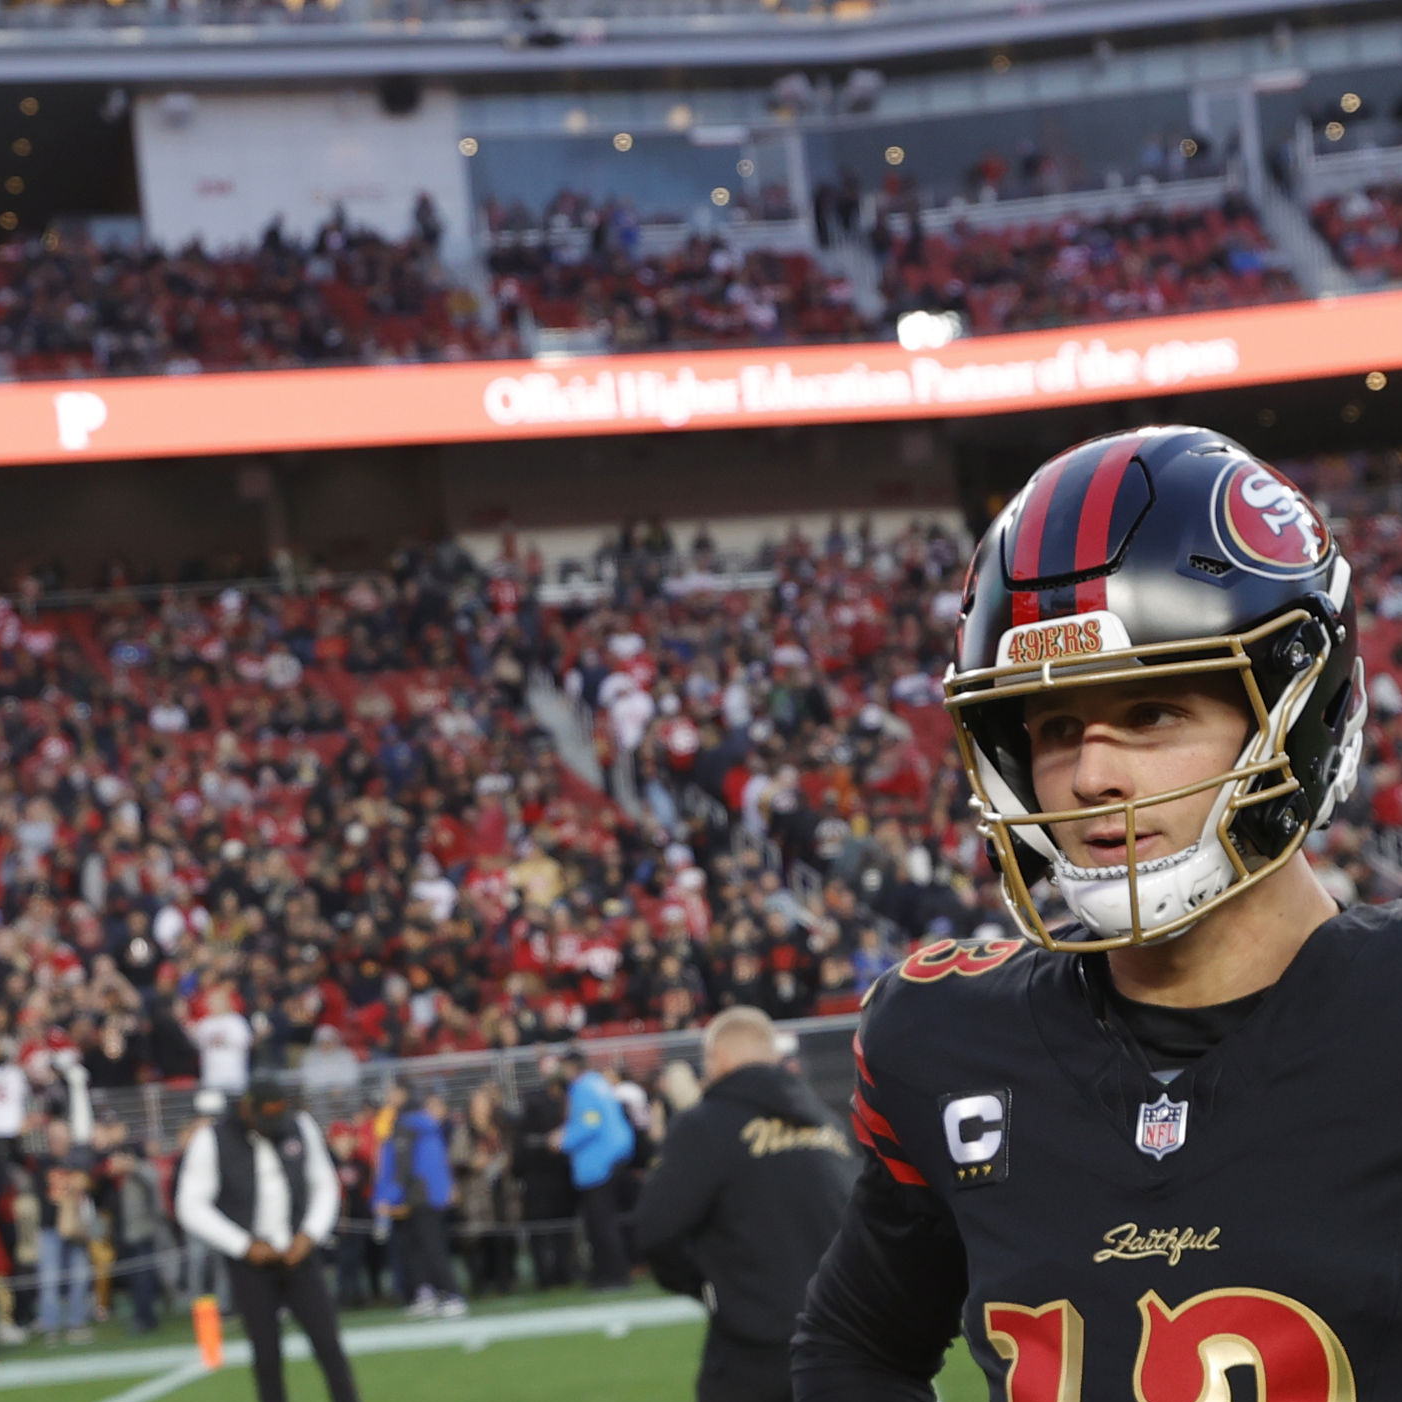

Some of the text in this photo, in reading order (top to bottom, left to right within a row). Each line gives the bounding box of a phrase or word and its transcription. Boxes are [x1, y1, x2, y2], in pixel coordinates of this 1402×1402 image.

[485, 370, 617, 425] Official
[617, 366, 738, 427] Higher
[739, 362, 912, 414] Education
[911, 357, 1036, 404] Partner
[1009, 621, 1103, 664] 49ERS
[942, 1094, 1004, 1164] C
[1144, 1123, 1177, 1148] NFL
[1093, 1222, 1221, 1266] Faithful
